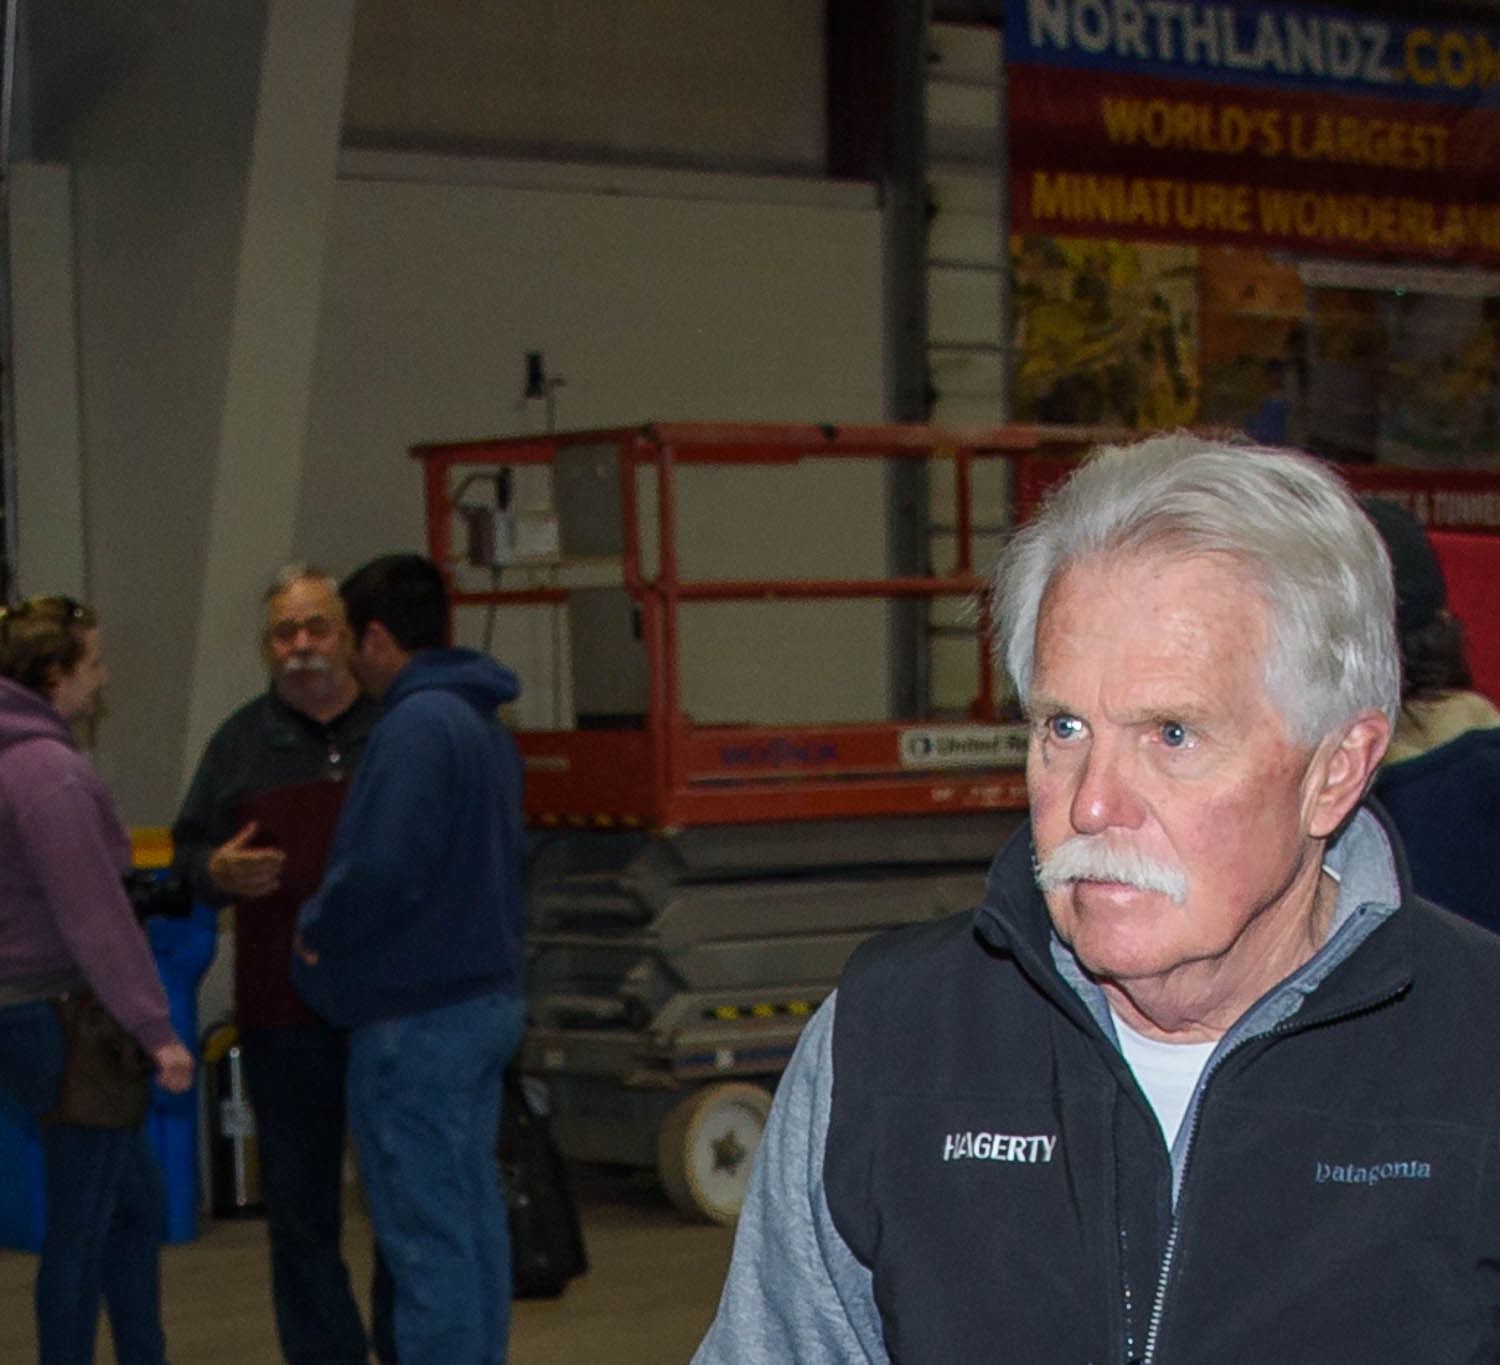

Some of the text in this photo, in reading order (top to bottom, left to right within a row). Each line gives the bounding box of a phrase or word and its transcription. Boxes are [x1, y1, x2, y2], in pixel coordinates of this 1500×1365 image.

[1102, 97, 1450, 171] WORLD'S LARGEST
[1032, 171, 1253, 233] MINIATURE
[943, 1132, 1056, 1164] HAGERTY
